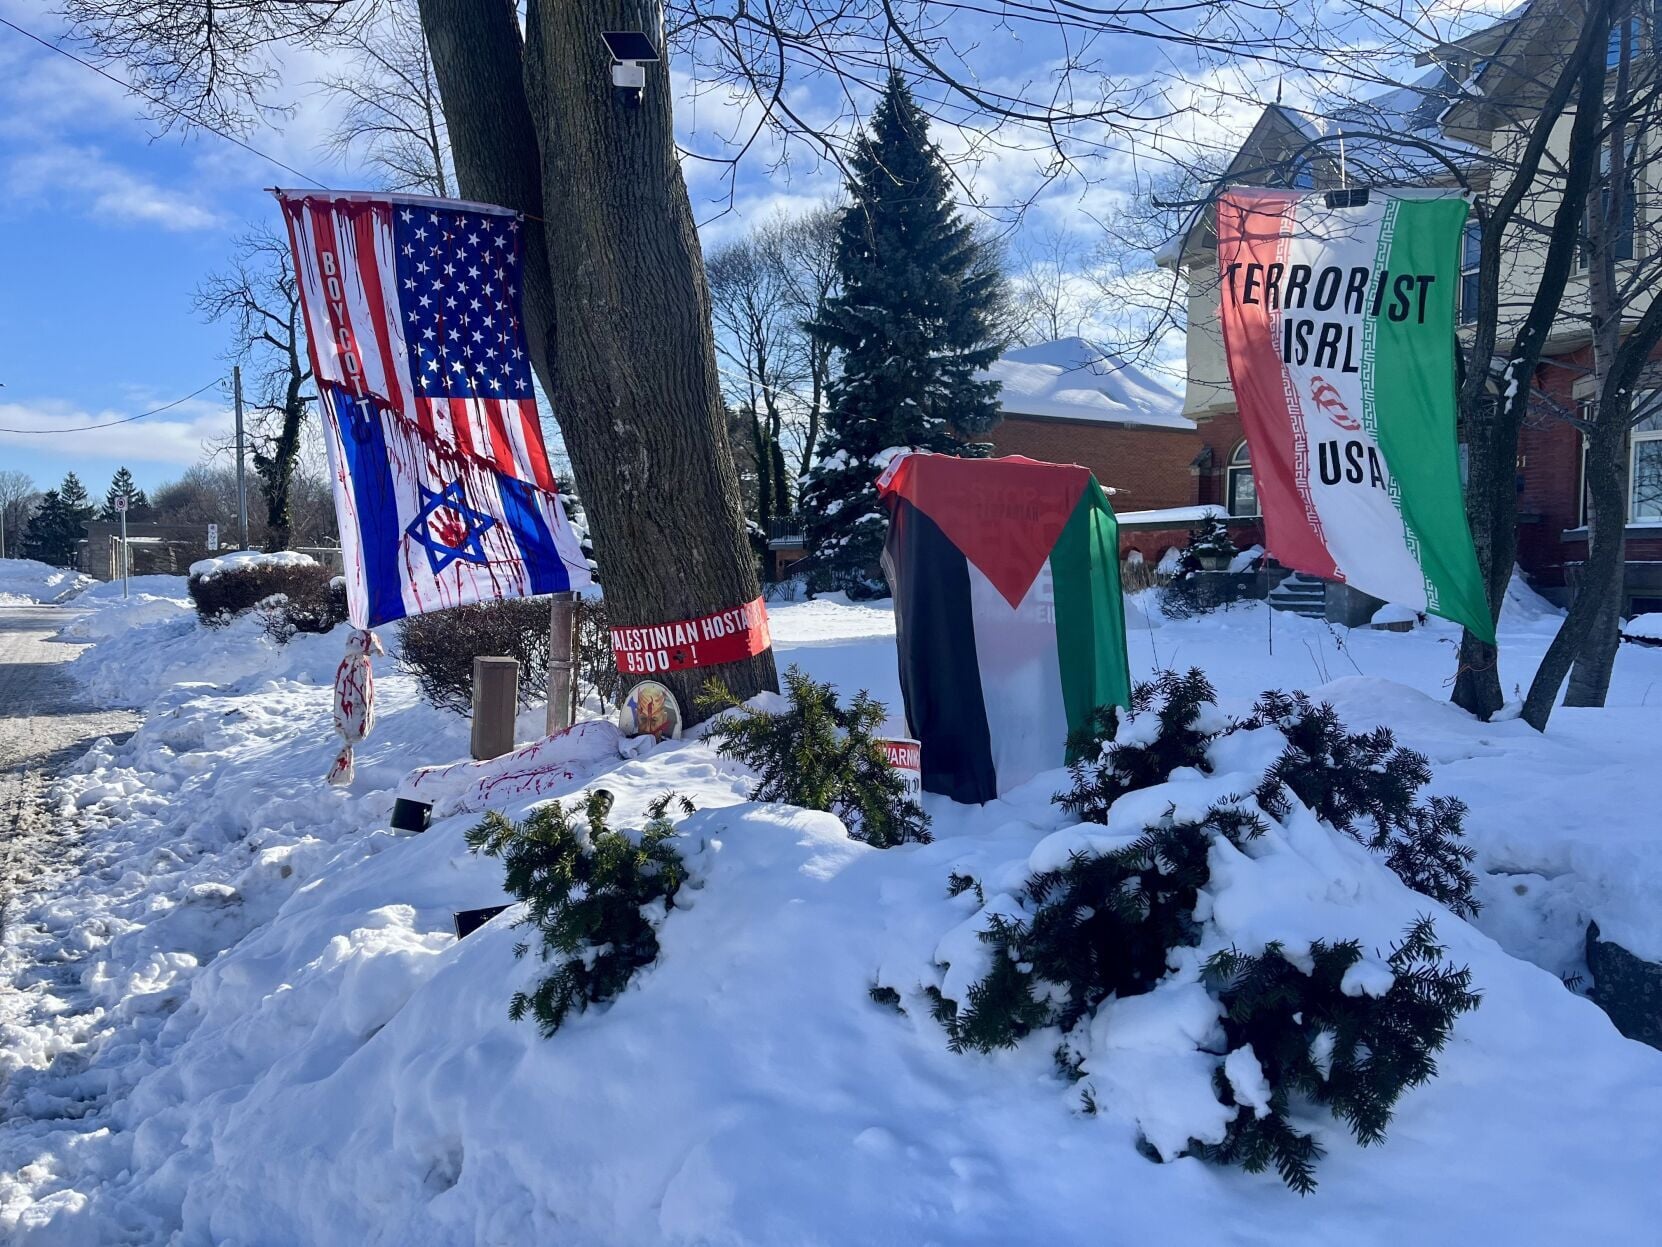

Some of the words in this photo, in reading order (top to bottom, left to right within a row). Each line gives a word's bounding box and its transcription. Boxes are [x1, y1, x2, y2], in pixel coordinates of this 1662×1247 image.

[1227, 262, 1435, 325] TERRORIST
[322, 251, 371, 424] BOYCOTT
[1284, 318, 1358, 373] ISRL
[1318, 440, 1387, 490] USA
[626, 650, 670, 673] 9500
[690, 645, 698, 664] !
